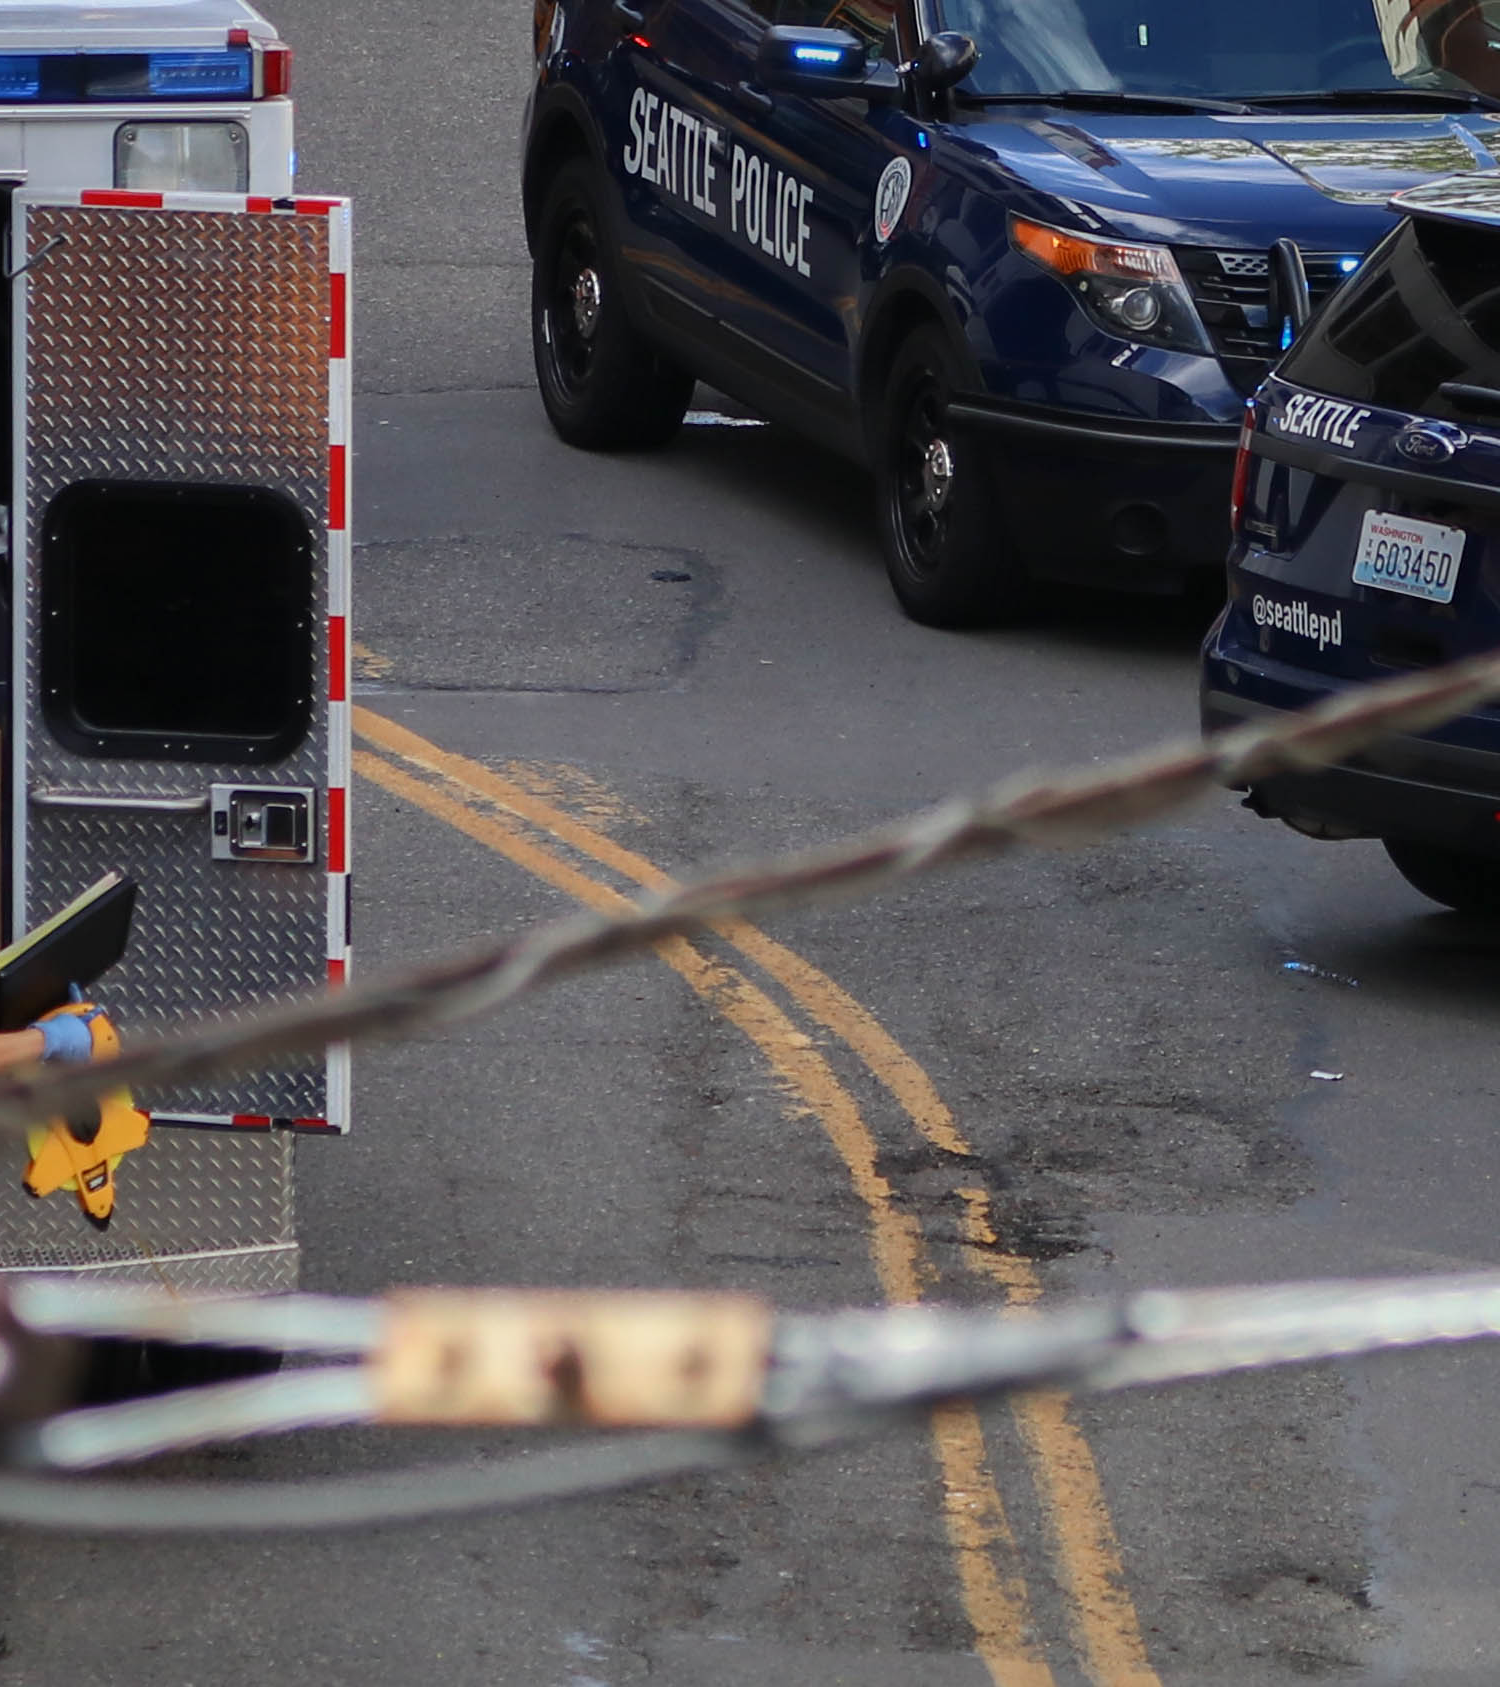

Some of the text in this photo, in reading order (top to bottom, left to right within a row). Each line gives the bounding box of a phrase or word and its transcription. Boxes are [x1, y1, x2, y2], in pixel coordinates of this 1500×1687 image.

[623, 87, 718, 218] SEATTLE
[731, 144, 814, 278] POLICE
[1279, 393, 1371, 450] SEATTLE
[1370, 523, 1424, 545] WASHINGTON
[1374, 540, 1453, 588] 60345D
[1252, 593, 1342, 651] @seattlepd
